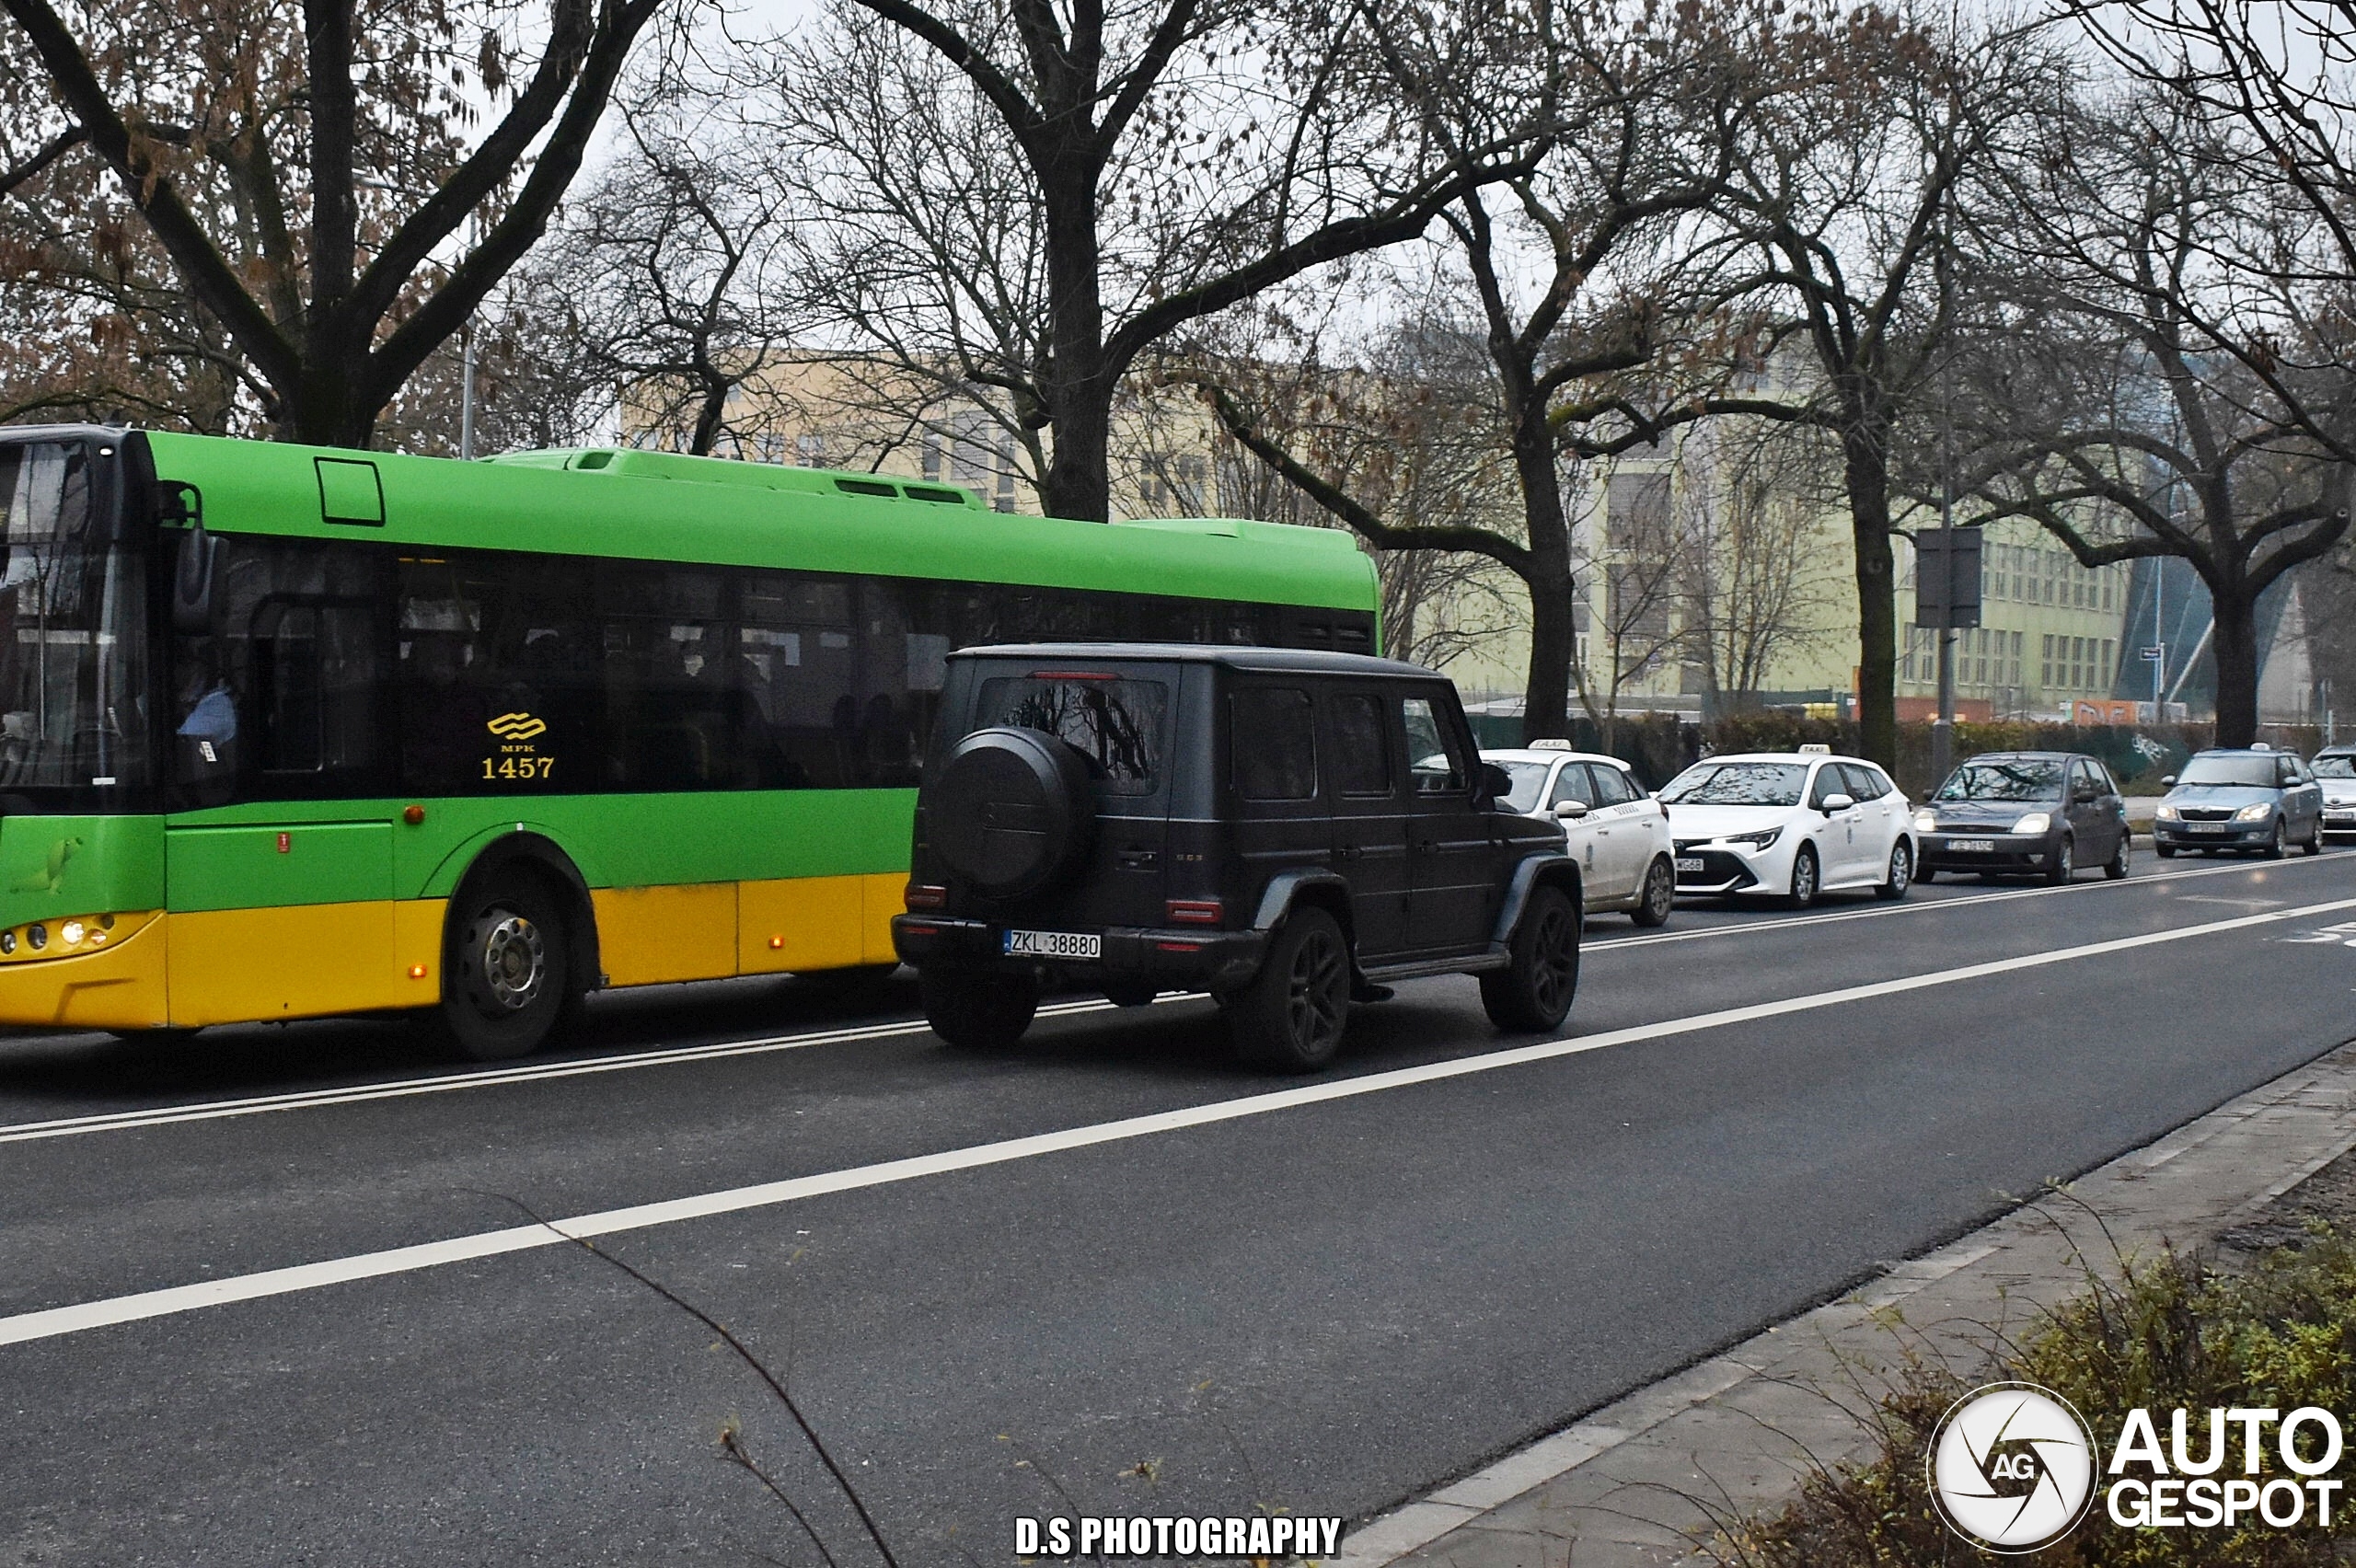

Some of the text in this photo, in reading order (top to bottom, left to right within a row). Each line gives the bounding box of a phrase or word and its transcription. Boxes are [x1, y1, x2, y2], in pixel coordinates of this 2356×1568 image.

[1534, 740, 1563, 748] TAXI
[482, 757, 554, 779] 1457
[1012, 932, 1098, 955] ZKL 38880
